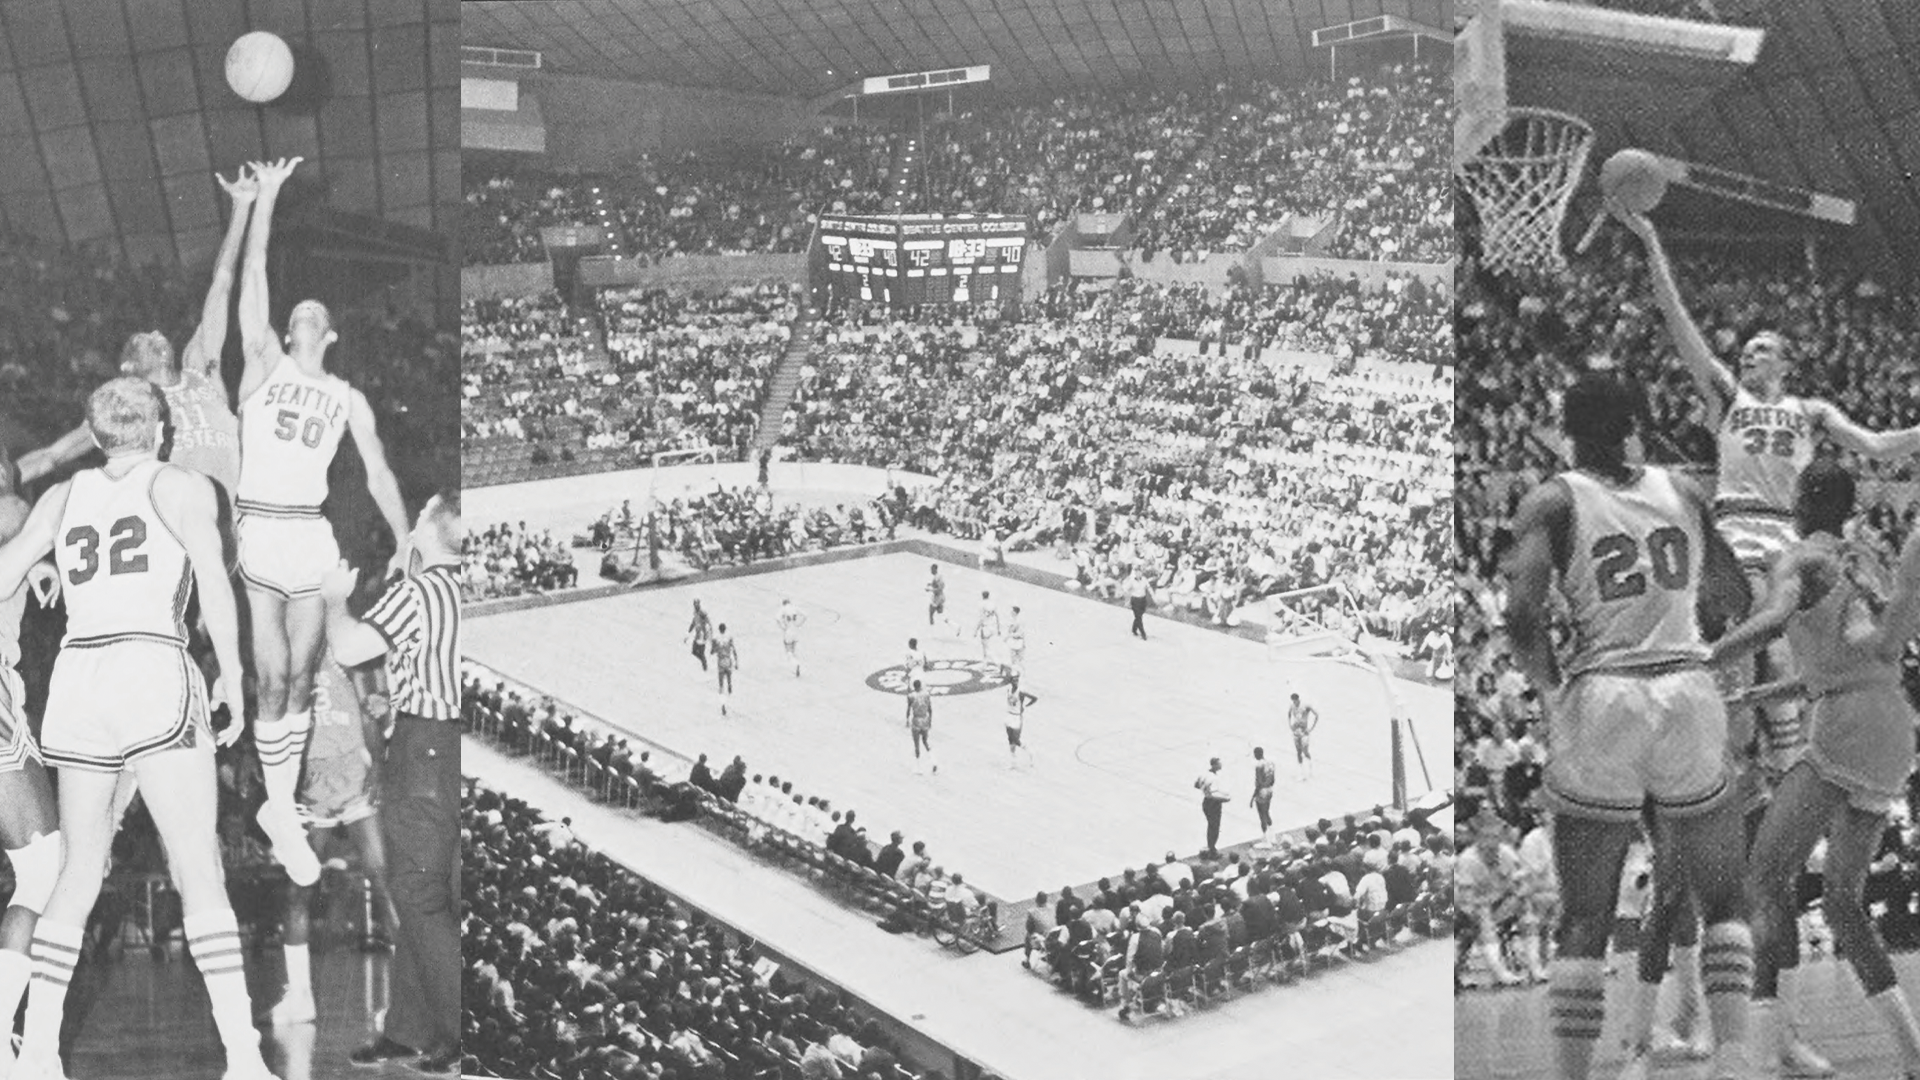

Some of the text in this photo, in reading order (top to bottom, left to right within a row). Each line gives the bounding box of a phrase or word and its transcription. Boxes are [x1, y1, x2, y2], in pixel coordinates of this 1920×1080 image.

[903, 224, 941, 235] SEATTLE
[943, 222, 979, 234] CENTER
[910, 250, 930, 267] 42
[1001, 246, 1021, 263] 40
[959, 275, 968, 288] 2
[176, 404, 210, 431] 11
[264, 383, 343, 428] SEATTLE
[274, 408, 326, 450] 50
[65, 515, 149, 586] 32
[1591, 525, 1690, 602] 20
